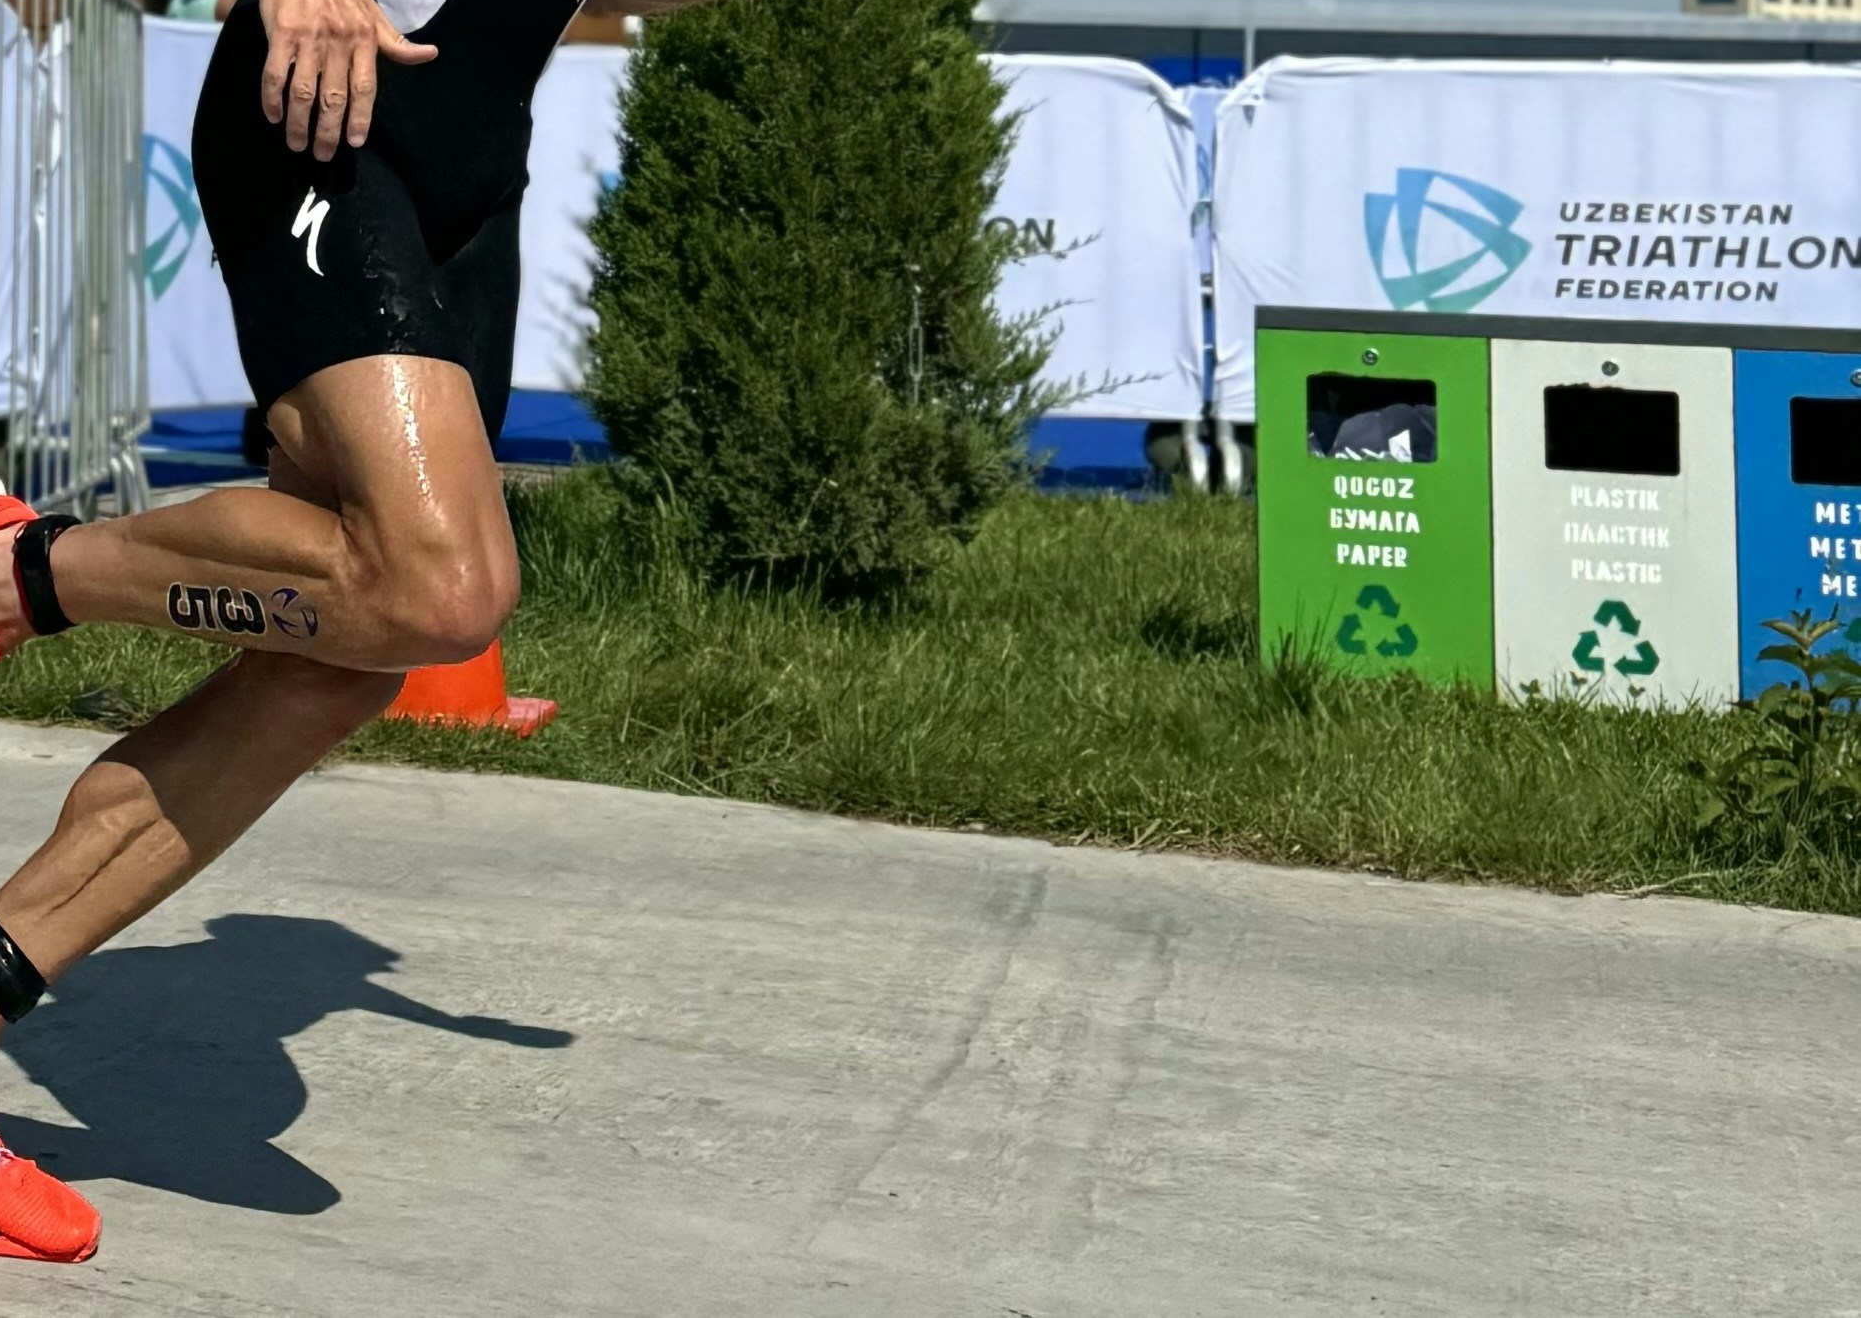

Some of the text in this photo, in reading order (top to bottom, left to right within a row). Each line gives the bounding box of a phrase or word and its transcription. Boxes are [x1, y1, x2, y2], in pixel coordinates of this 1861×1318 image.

[1559, 202, 1793, 225] UZBEKISTAN
[1555, 234, 1861, 270] TRIATHLON
[1555, 278, 1778, 302] FEDERATION
[1571, 485, 1659, 511] PLASTIK
[1330, 508, 1420, 533] БУМАГА
[1564, 521, 1670, 548] ПЛАСТИК
[1337, 543, 1407, 567] PAPER
[1571, 559, 1662, 584] PLASTIC
[167, 583, 267, 634] 35
